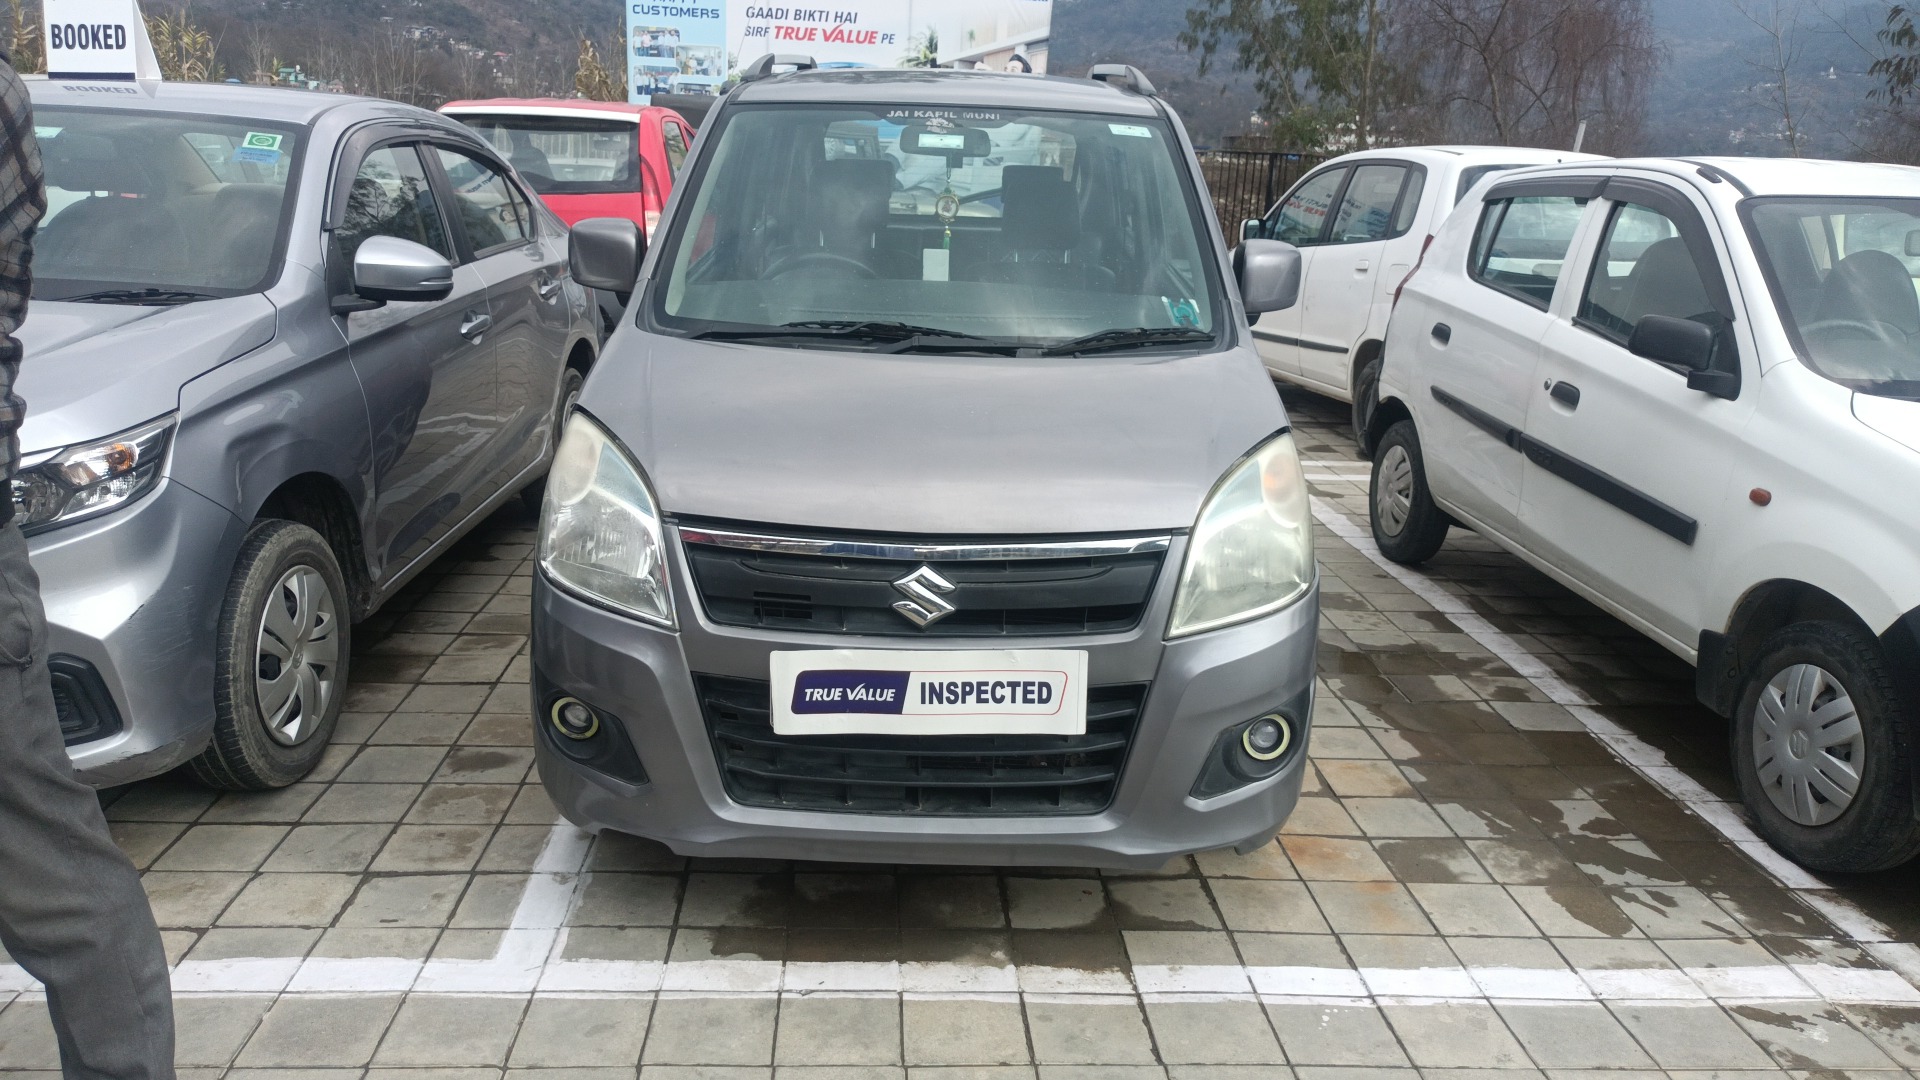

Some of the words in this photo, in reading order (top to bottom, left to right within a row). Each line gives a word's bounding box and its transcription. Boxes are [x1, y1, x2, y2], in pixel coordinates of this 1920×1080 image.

[632, 4, 720, 19] CUSTOMERS
[745, 6, 789, 21] GAADI
[793, 8, 830, 23] BIKTI
[833, 11, 858, 24] HAI
[51, 23, 126, 50] BOOKED
[744, 25, 770, 38] SIRF
[774, 25, 818, 43] TRUE
[822, 22, 879, 45] VALUE
[881, 33, 895, 45] PE
[886, 110, 909, 118] JAI
[804, 687, 842, 702] TRUE
[846, 682, 896, 702] VALUE
[920, 680, 1053, 705] INSPECTED
